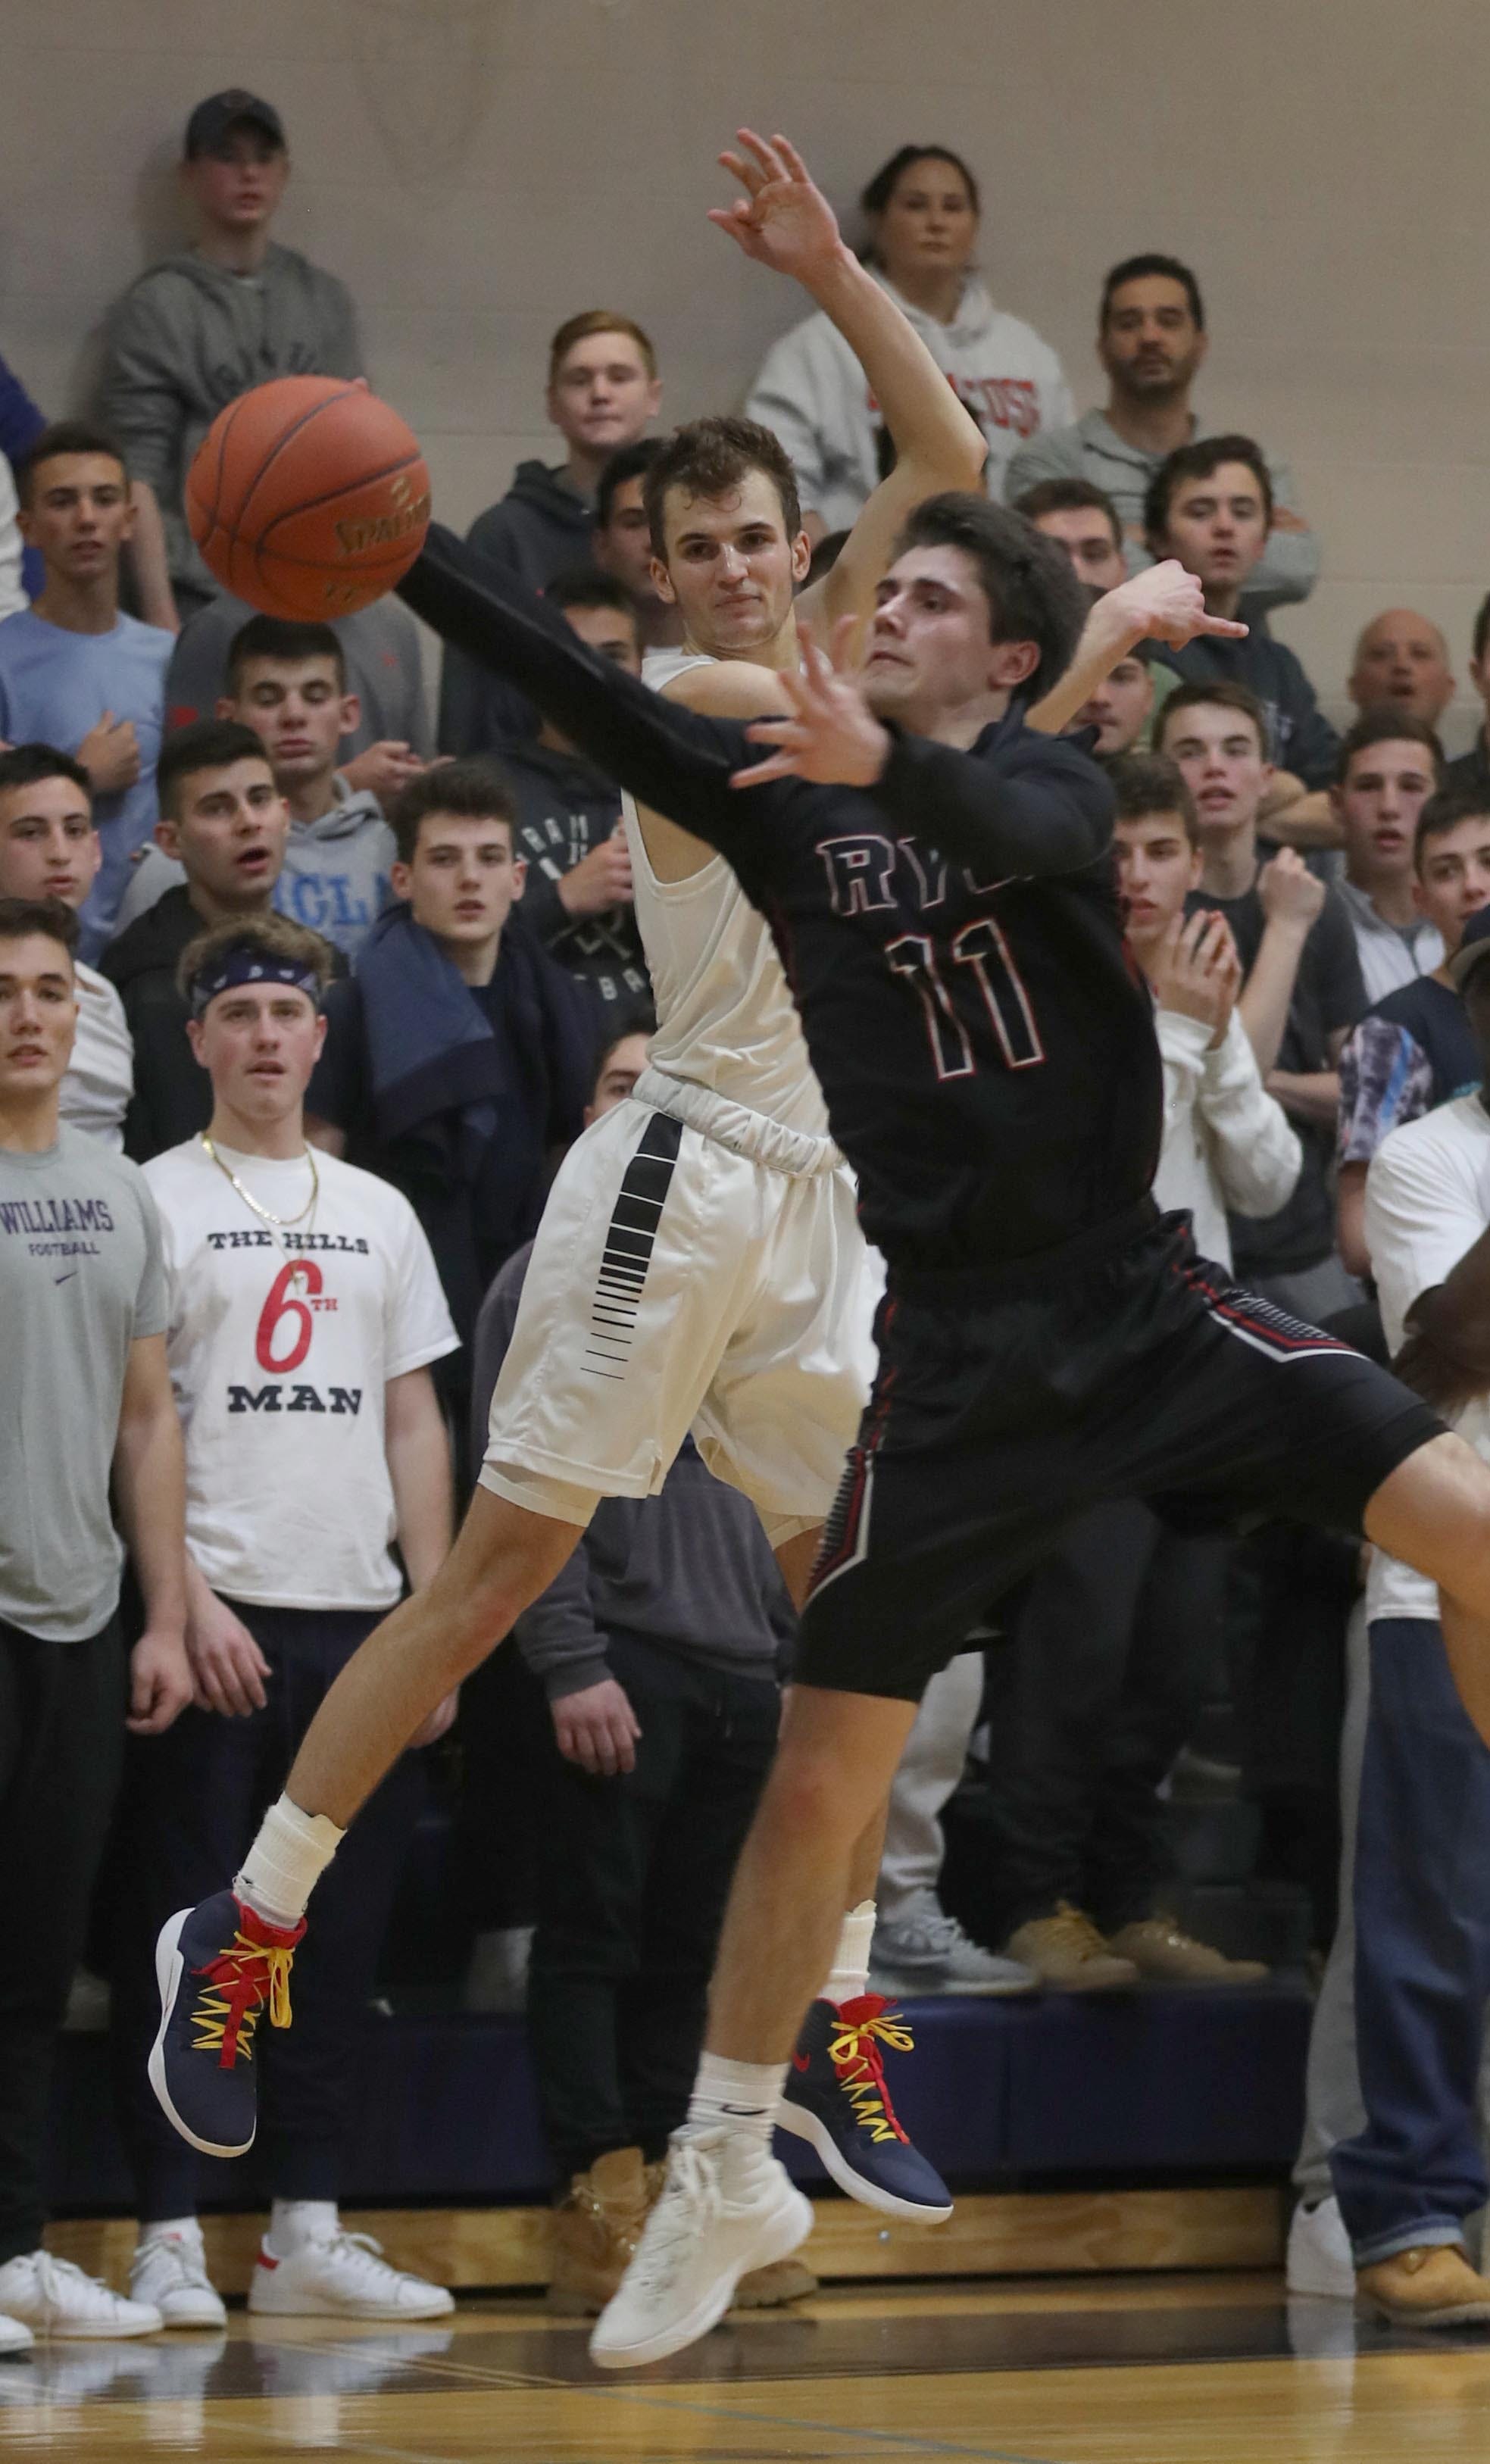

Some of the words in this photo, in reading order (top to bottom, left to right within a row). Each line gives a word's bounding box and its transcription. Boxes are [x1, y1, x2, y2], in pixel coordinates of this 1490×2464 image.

[883, 917, 1048, 1080] 11
[0, 1199, 114, 1235] WILLIAMS
[28, 1241, 101, 1257] FOOTBALL
[207, 1231, 273, 1250] THE
[283, 1232, 370, 1255] HILLS
[227, 1385, 362, 1416] MAN
